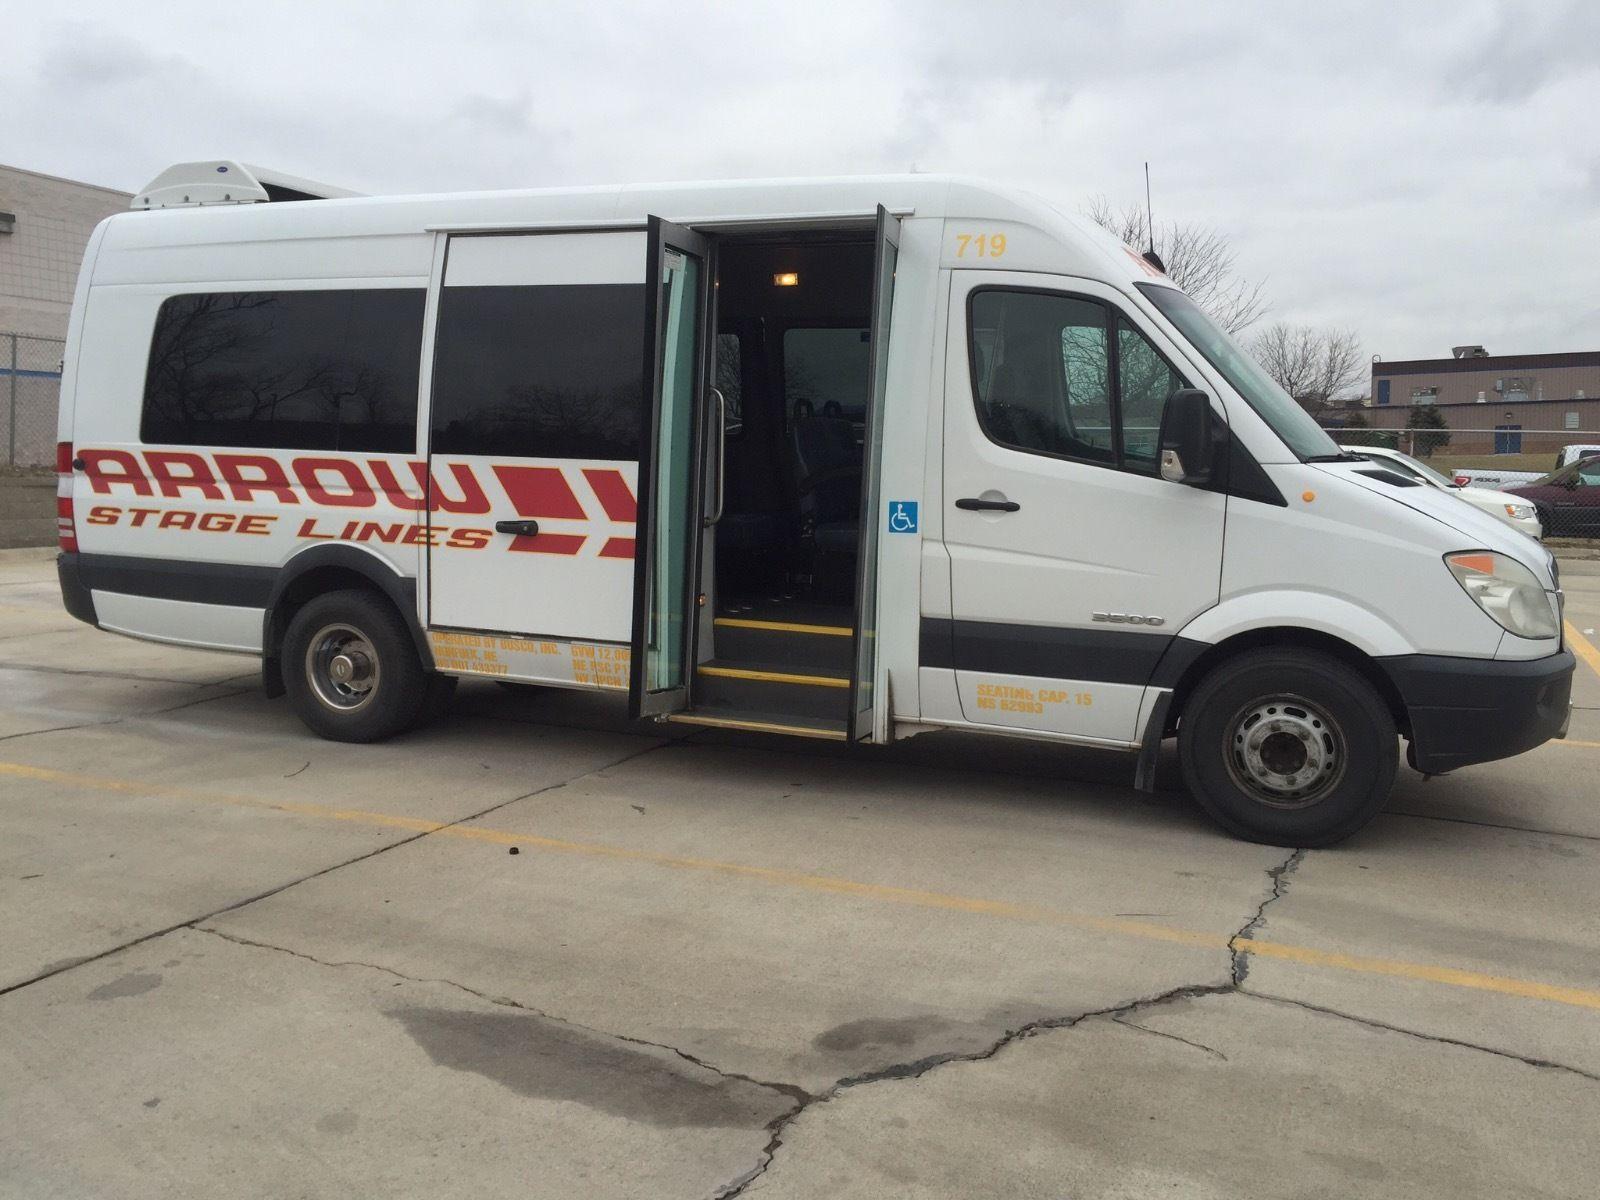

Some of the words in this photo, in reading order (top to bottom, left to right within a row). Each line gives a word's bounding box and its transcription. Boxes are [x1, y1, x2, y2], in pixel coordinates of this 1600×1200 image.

[955, 232, 1007, 258] 719
[76, 448, 492, 515] ARROW
[86, 505, 278, 536] STAGE
[295, 517, 493, 549] LINES
[1038, 689, 1071, 704] CAP.
[1075, 692, 1093, 706] 15
